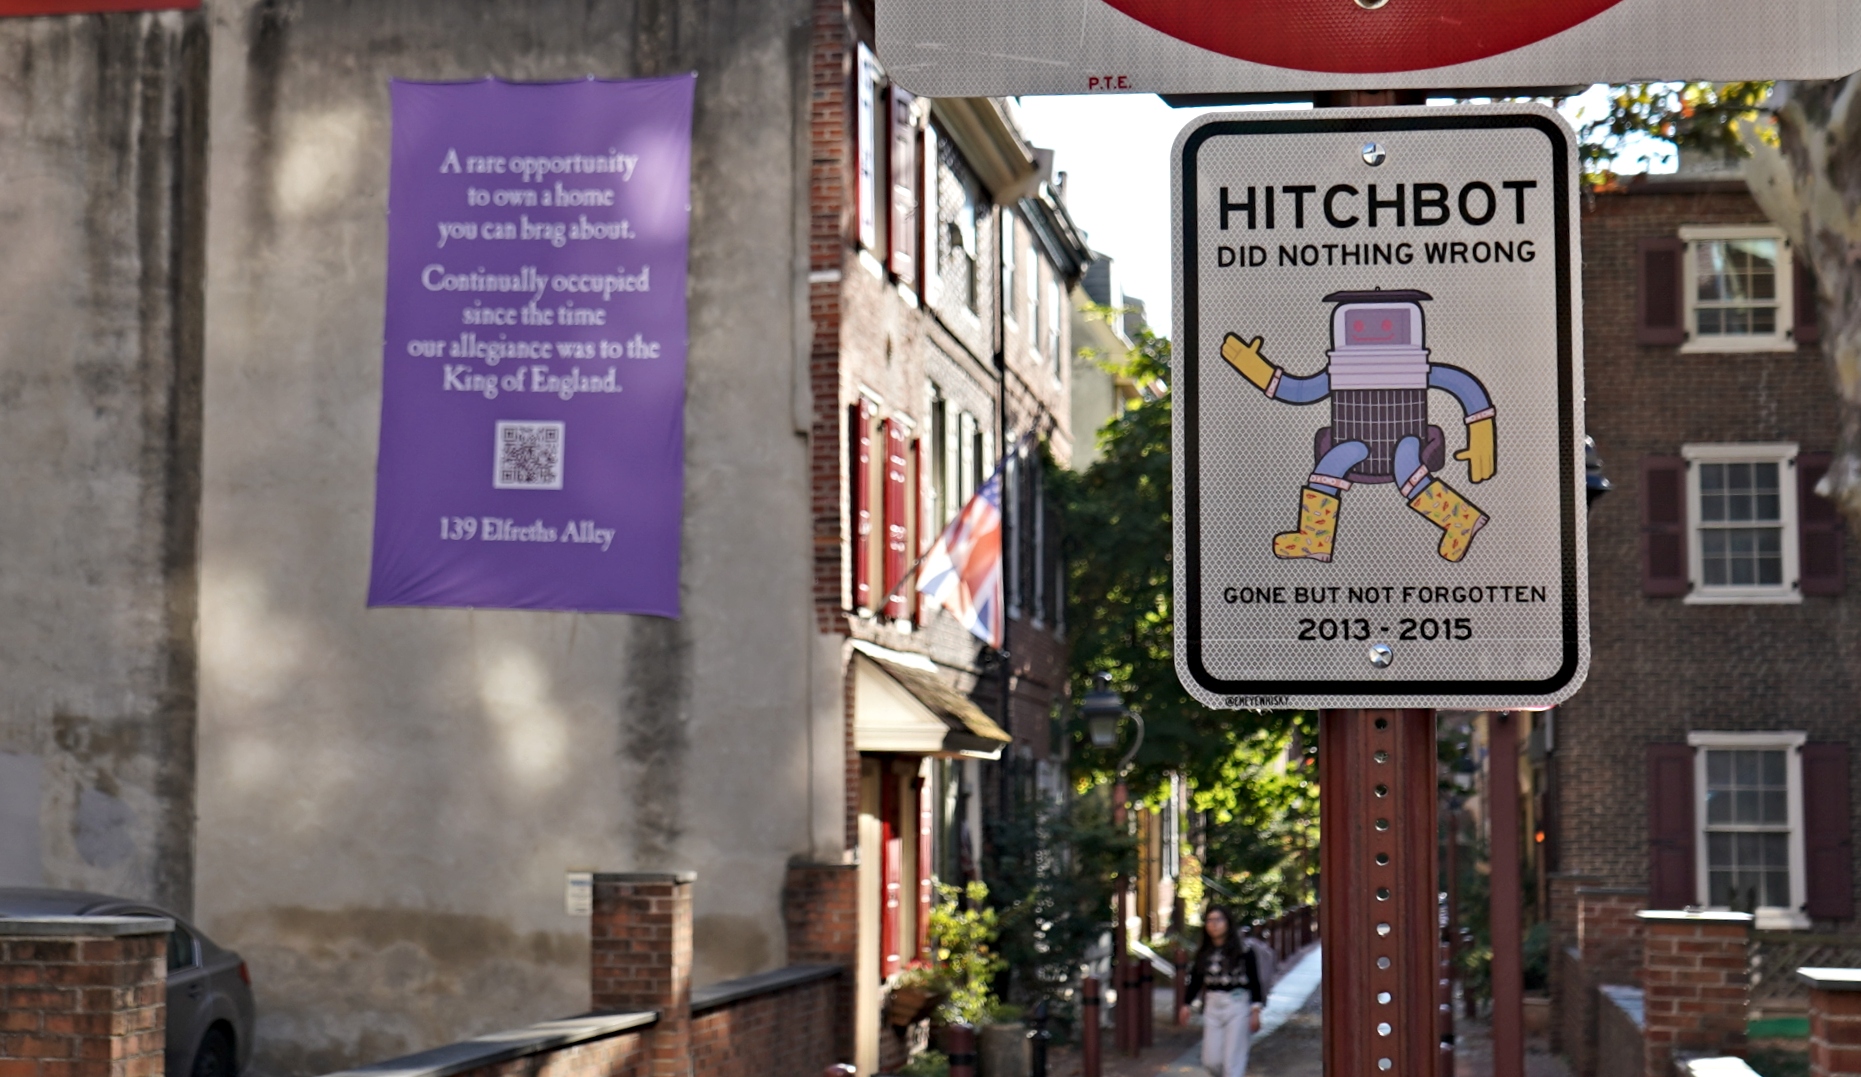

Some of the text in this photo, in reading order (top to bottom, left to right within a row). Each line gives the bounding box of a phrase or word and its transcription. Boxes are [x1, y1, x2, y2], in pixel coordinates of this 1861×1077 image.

[1089, 75, 1132, 90] P.T.E.
[439, 147, 639, 183] A rare opportunity
[467, 180, 615, 207] to own a home
[1219, 180, 1538, 231] HITCHBOT
[437, 214, 636, 249] you can brag about.
[1217, 240, 1537, 268] DID NOTHING WRONG
[421, 263, 651, 303] Continually occupied
[462, 299, 606, 326] since the time
[407, 331, 661, 367] our allegiance was to the
[443, 364, 623, 401] King of England.
[440, 516, 616, 552] 139 Elfreths Alley
[1223, 585, 1546, 604] GONE BUT NOT FORGOTTEN
